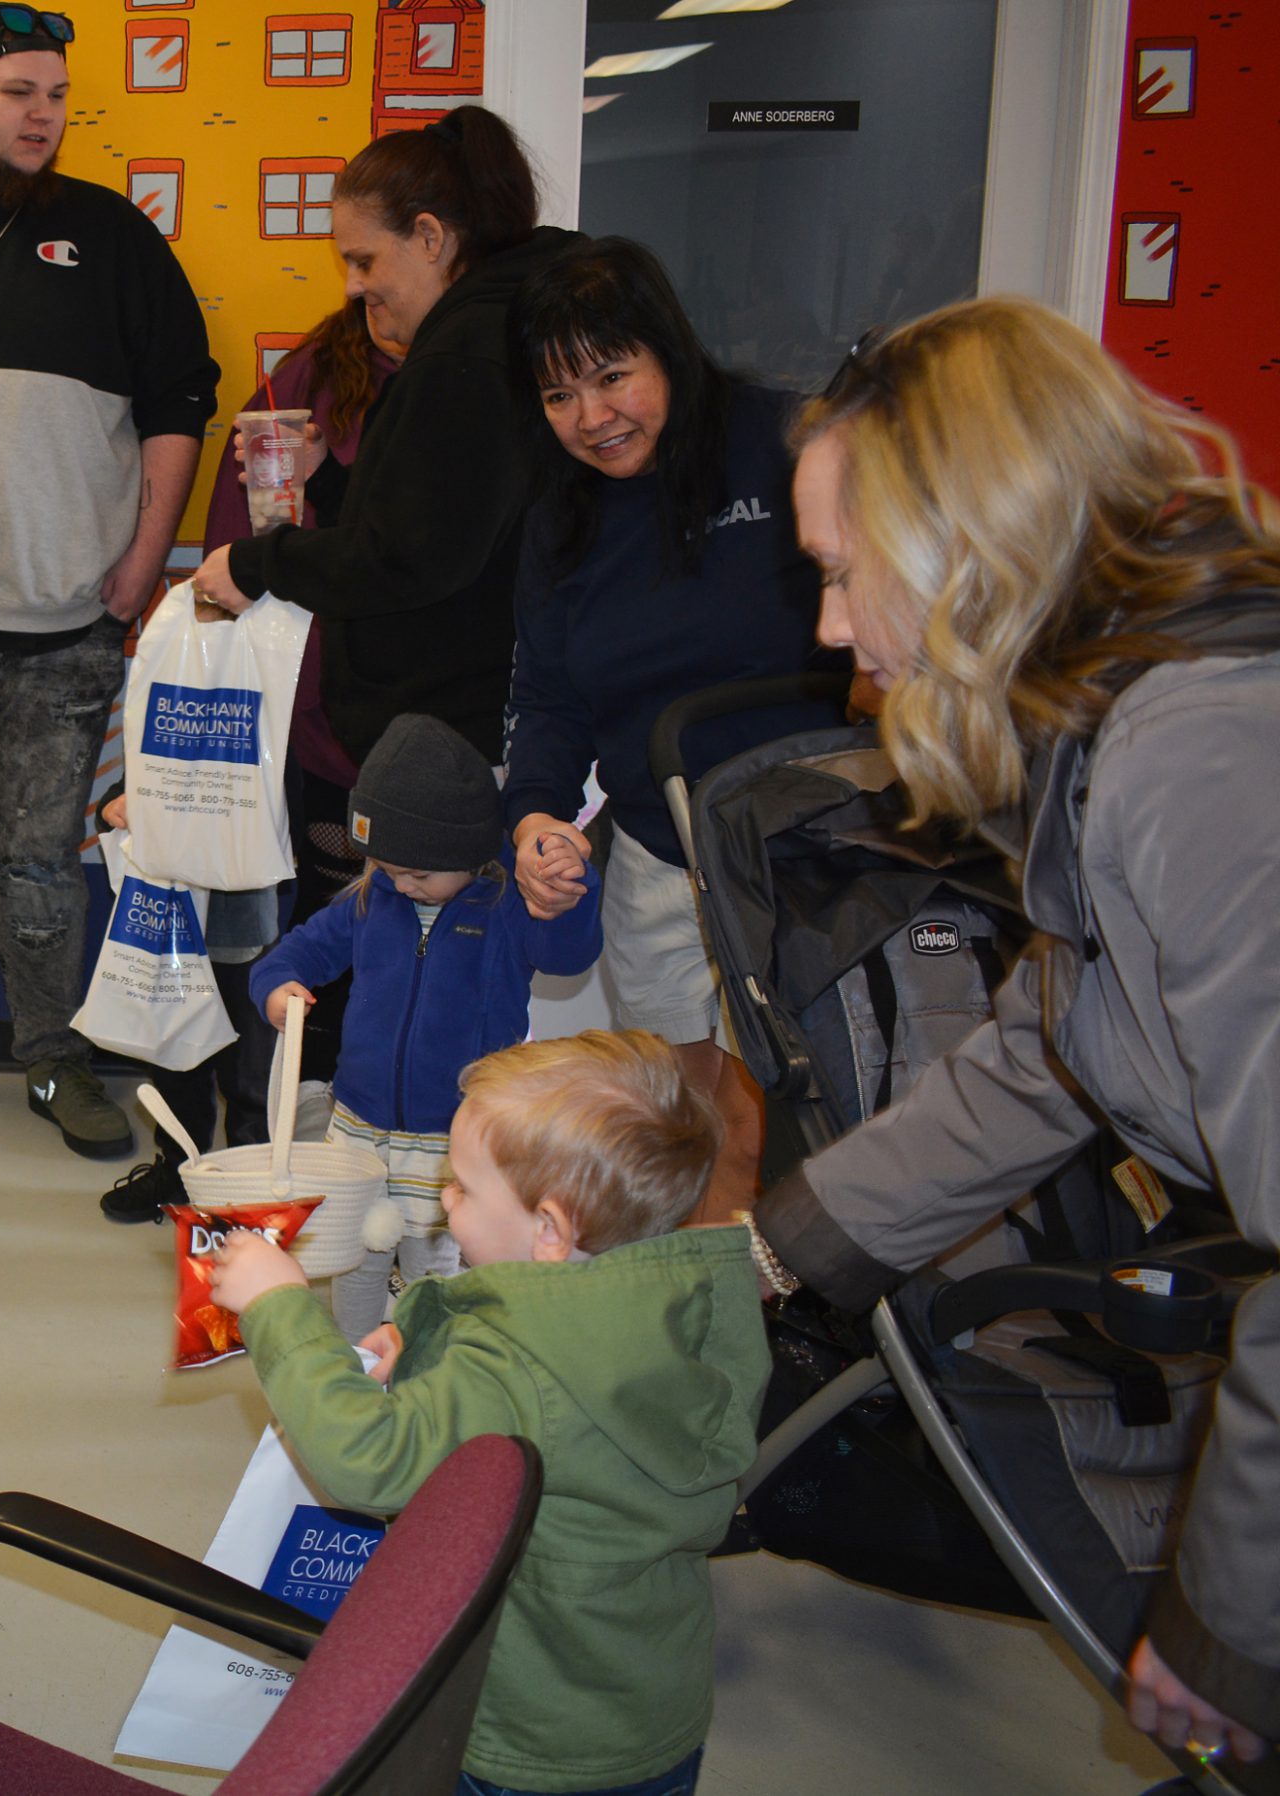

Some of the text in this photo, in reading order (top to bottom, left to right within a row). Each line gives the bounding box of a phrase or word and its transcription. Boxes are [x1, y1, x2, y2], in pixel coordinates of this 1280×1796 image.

[732, 110, 835, 122] ANNE SODERBERG
[156, 697, 252, 718] BLACKHAWK
[154, 715, 253, 736] COMMUNITY
[154, 734, 200, 747] CREDIT
[916, 925, 956, 948] chicco
[300, 1528, 379, 1558] BLACK
[290, 1555, 364, 1583] COMM
[227, 1661, 295, 1683] 608-755-6
